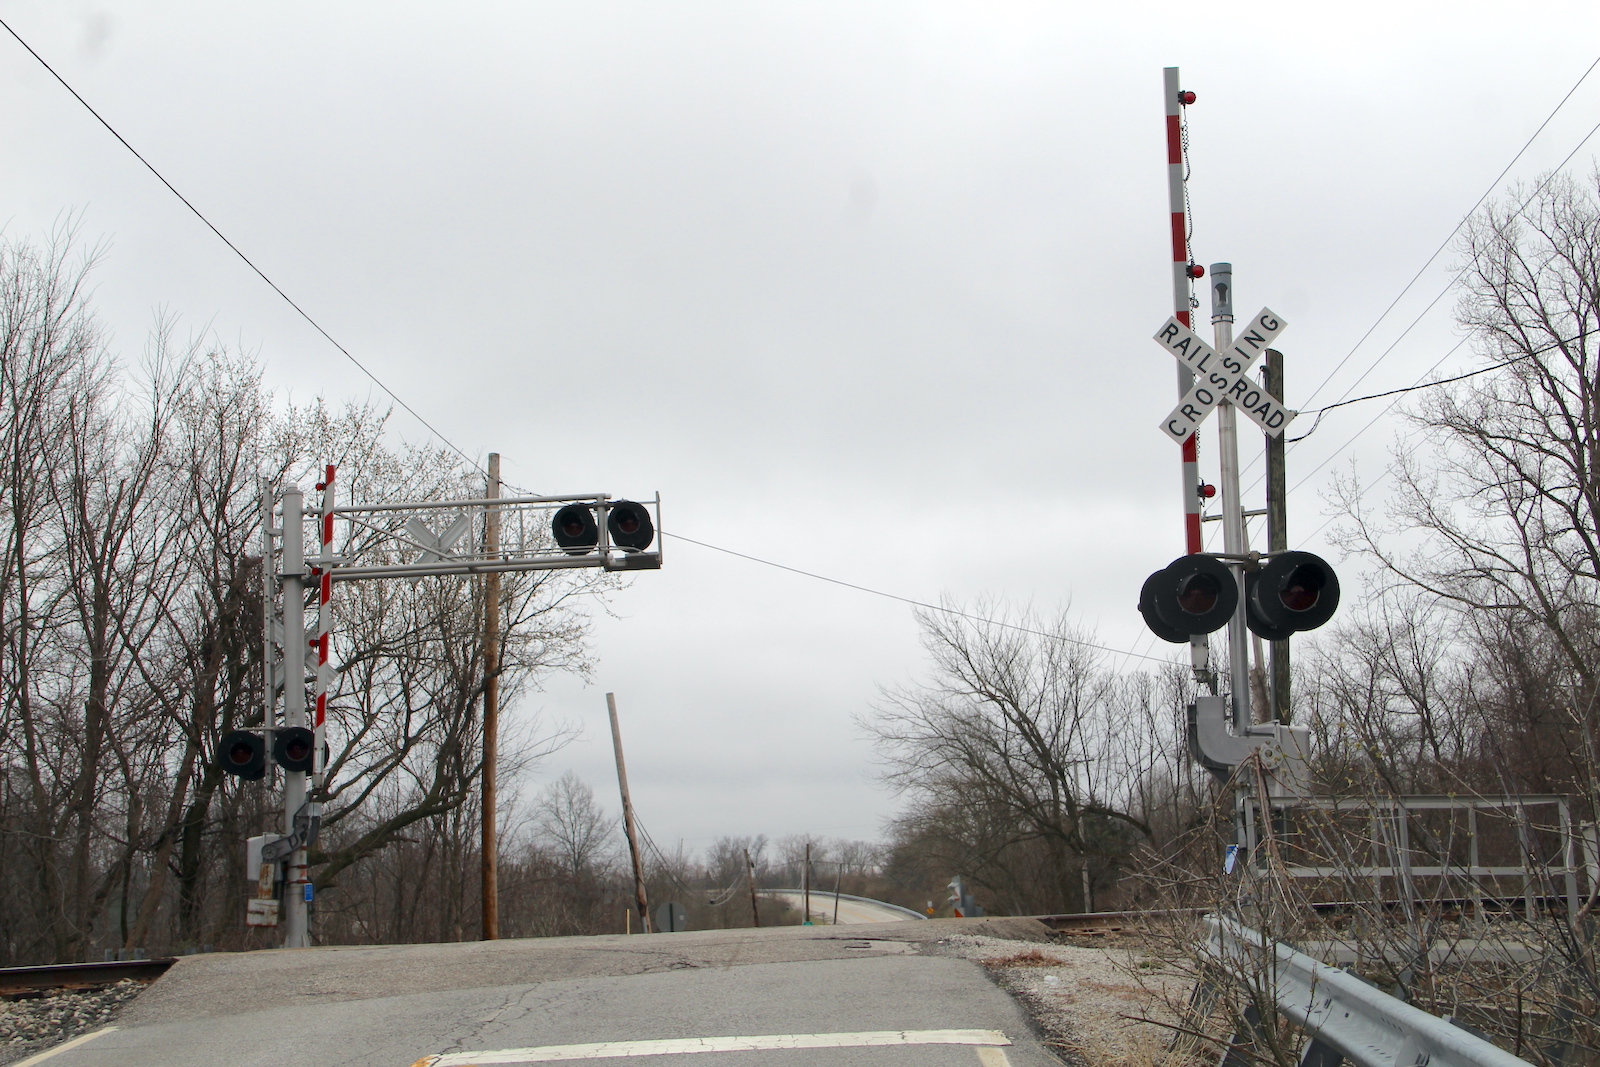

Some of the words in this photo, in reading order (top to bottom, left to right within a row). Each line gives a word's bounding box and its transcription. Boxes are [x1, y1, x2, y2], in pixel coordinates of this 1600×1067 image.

[1159, 323, 1211, 373] RAIL
[1228, 378, 1285, 429] ROAD
[1168, 315, 1279, 437] CROSSING
